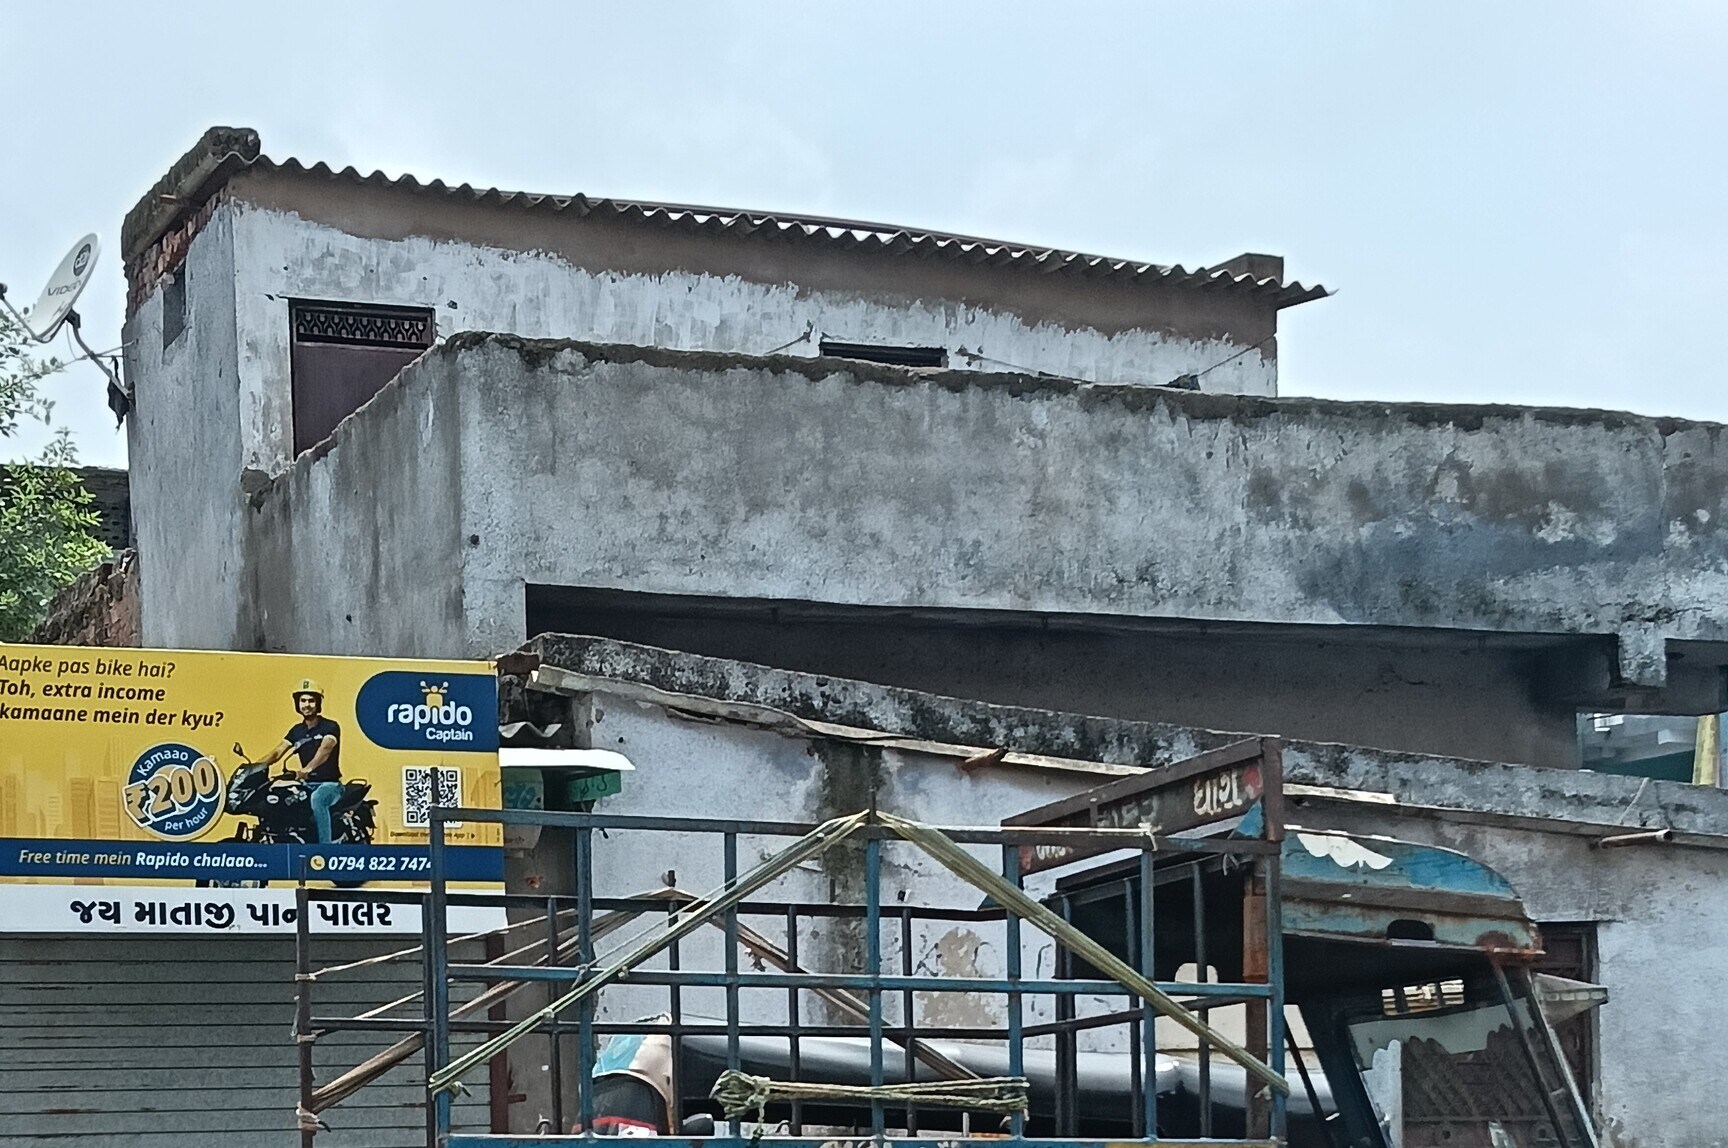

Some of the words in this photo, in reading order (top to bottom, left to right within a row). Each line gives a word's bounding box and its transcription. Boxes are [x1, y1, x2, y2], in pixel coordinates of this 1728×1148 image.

[0, 655, 52, 676] Aapke
[57, 659, 90, 677] pas
[95, 658, 133, 676] bike
[138, 661, 176, 678] hai?
[0, 679, 36, 698] Toh,
[42, 683, 92, 699] extra
[97, 682, 166, 701] income
[0, 703, 88, 721] kamaane
[93, 707, 140, 724] mein
[145, 709, 177, 725] der
[181, 710, 224, 730] kyu?
[387, 701, 473, 730] rapido
[426, 728, 473, 743] Captain
[136, 749, 189, 776] Kamaao
[164, 820, 184, 831] per
[185, 807, 208, 828] hour
[19, 850, 51, 864] Free
[56, 850, 90, 864] time
[94, 852, 132, 865] mein
[135, 852, 190, 869] Rapido
[328, 856, 365, 871] 0794
[368, 857, 396, 871] 822
[70, 901, 121, 924] જય
[134, 902, 236, 929] માતાજી
